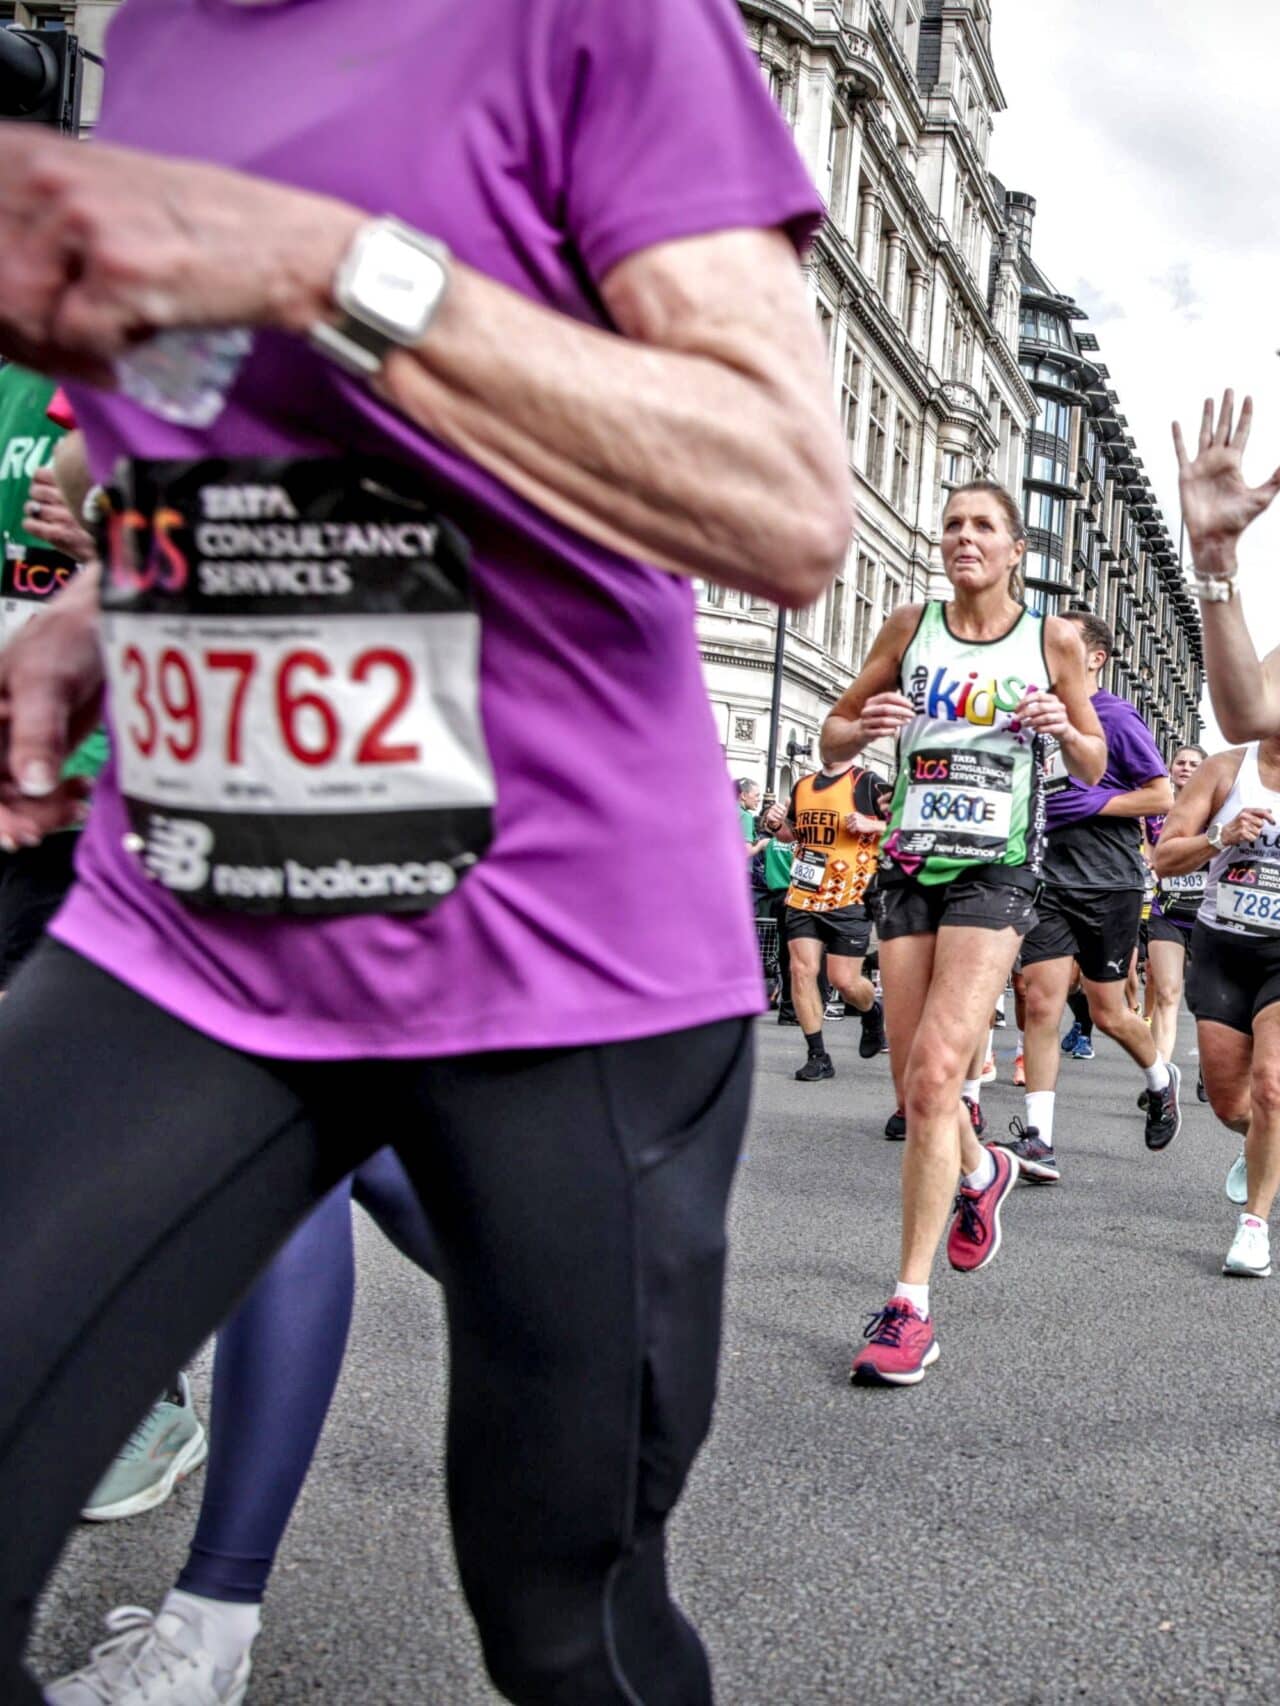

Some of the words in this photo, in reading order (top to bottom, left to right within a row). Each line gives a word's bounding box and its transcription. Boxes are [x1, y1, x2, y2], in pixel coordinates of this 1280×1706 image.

[200, 484, 297, 519] TATA
[196, 523, 437, 557] CONSULTANCY
[199, 560, 353, 595] SERVICES
[122, 647, 420, 766] 39762
[928, 666, 1026, 726] kids
[915, 756, 949, 779] tcs
[951, 754, 977, 764] TATA
[212, 864, 283, 898] new
[284, 858, 456, 899] balance
